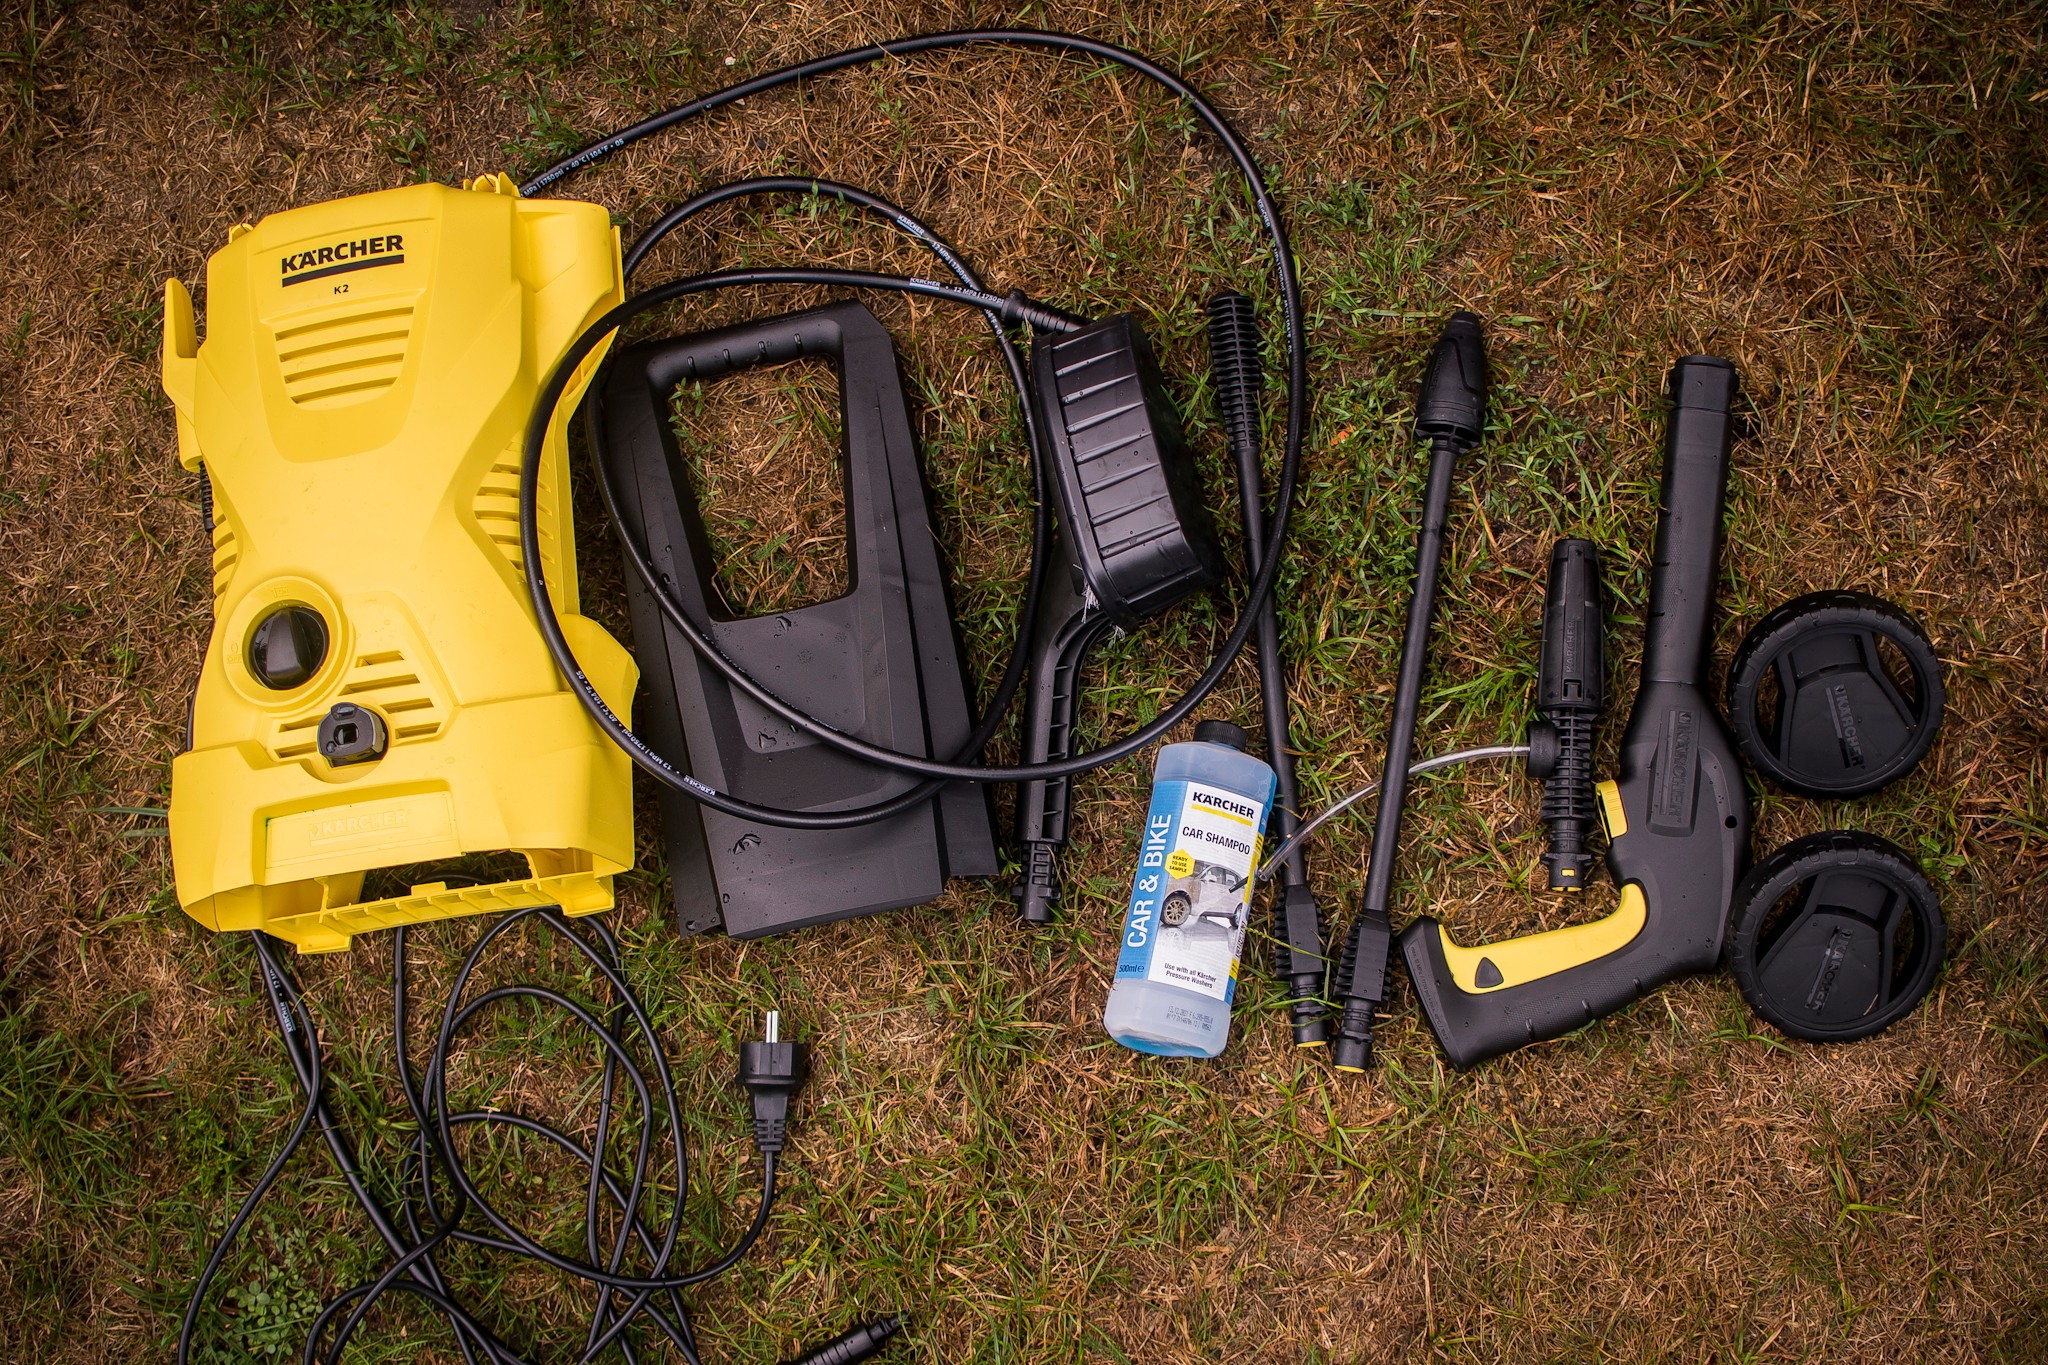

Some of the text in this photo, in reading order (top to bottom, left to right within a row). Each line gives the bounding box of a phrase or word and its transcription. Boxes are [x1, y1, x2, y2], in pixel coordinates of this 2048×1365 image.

[282, 235, 404, 274] KÄRCHER
[1192, 791, 1255, 819] KÄRCHER
[1182, 826, 1204, 840] CAR
[1205, 831, 1251, 855] SHAMPOO
[1127, 814, 1172, 948] CAR & BIKE
[1169, 865, 1187, 873] SAMPLE
[1164, 963, 1175, 971] Use
[1176, 965, 1189, 974] with
[1197, 971, 1217, 983] Kärcher
[1165, 970, 1213, 989] Pressure Washers
